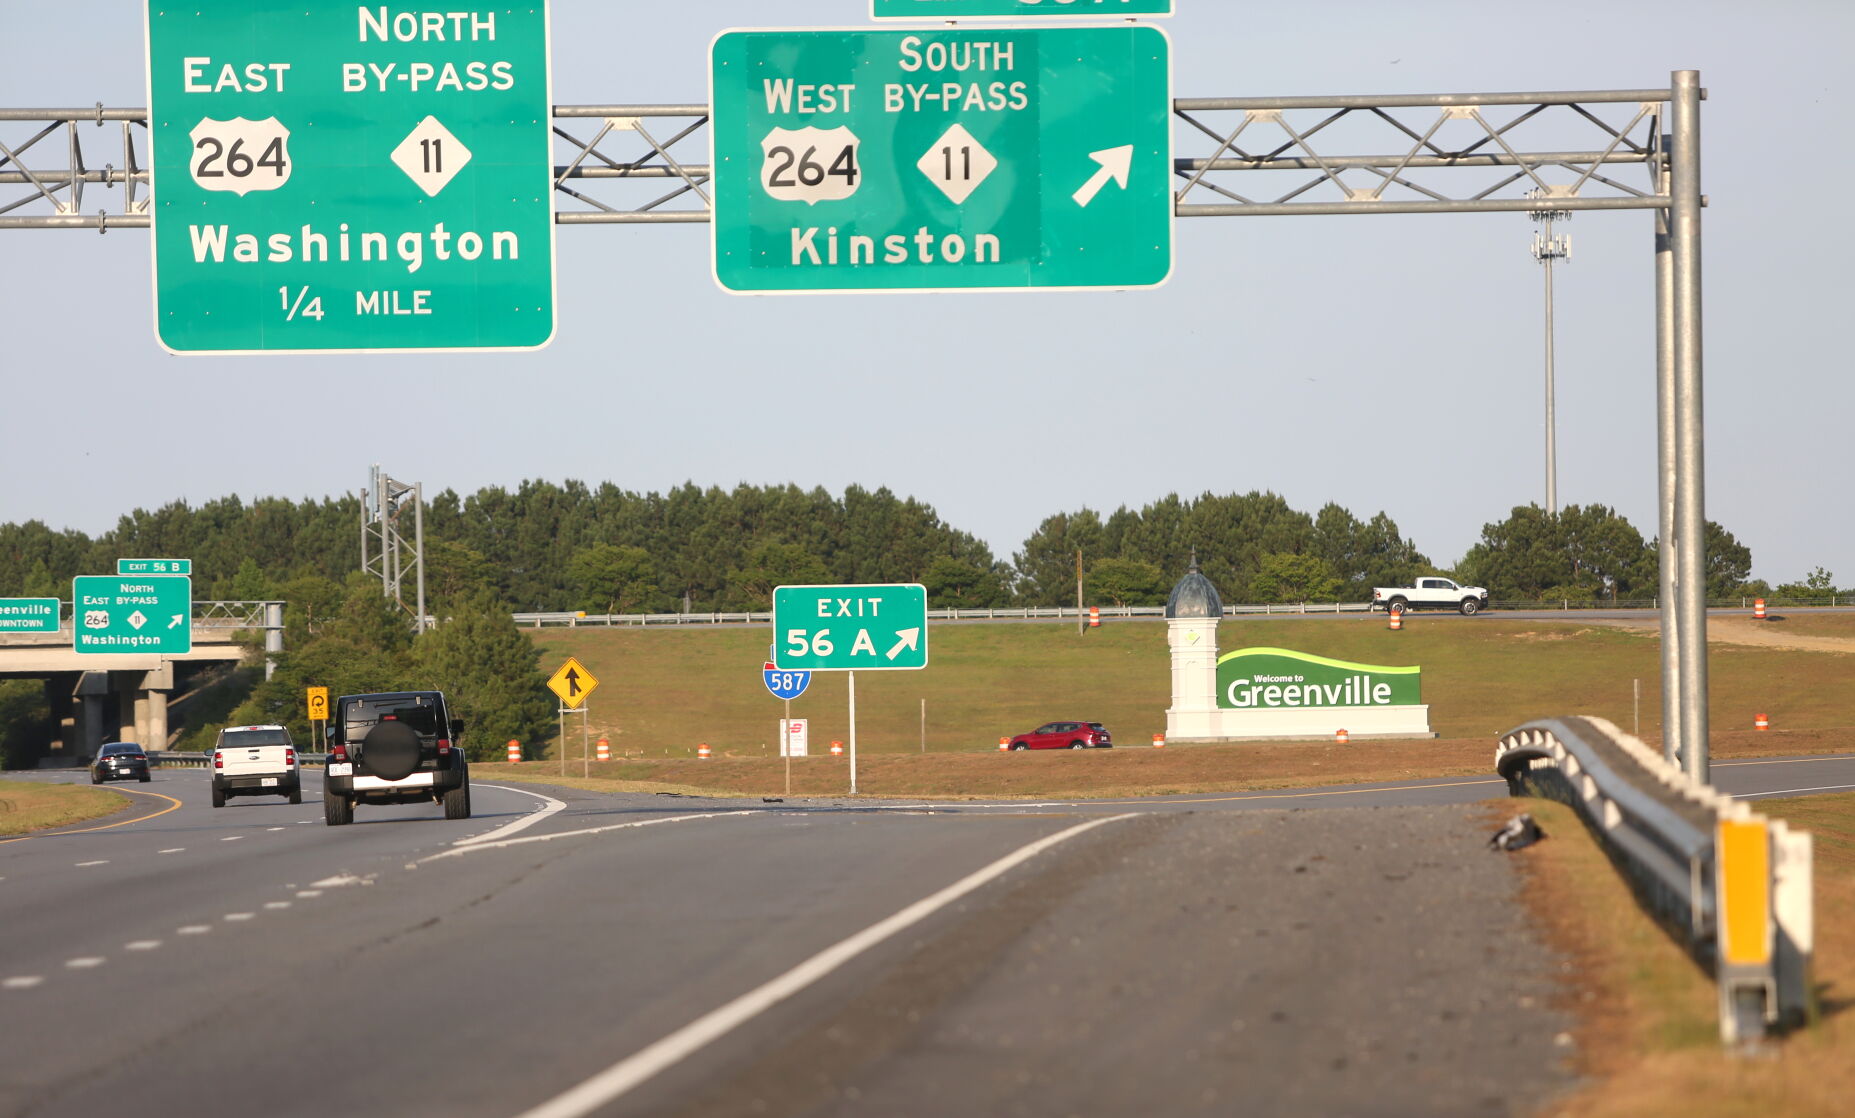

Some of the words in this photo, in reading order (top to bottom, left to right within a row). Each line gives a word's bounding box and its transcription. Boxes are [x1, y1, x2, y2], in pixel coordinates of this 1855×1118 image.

[358, 6, 497, 42] NORTH
[899, 36, 1015, 72] SOUTH
[184, 57, 291, 93] EAST
[343, 61, 515, 92] BY-PASS
[763, 78, 856, 114] WEST
[885, 80, 1028, 113] BY-PASS
[196, 136, 287, 178] 264
[420, 138, 443, 173] 11
[768, 144, 858, 188] 264
[942, 145, 971, 181] 11
[189, 221, 519, 273] Washington
[791, 226, 1000, 265] Kinston
[356, 290, 433, 315] MILE
[129, 563, 148, 571] EXIT
[153, 562, 167, 572] 56
[172, 562, 180, 572] B
[83, 596, 110, 605] EAST
[116, 596, 159, 605] BY-PASS
[120, 584, 154, 593] NORTH
[86, 614, 109, 625] 264
[134, 615, 141, 625] 11
[817, 597, 883, 617] EXIT
[0, 619, 44, 628] WNTOWN
[82, 634, 161, 647] Washington
[786, 628, 835, 657] 56
[850, 628, 877, 656] A
[771, 673, 804, 691] 587
[1227, 675, 1392, 707] Greenville
[1253, 674, 1293, 683] Welcome
[1294, 674, 1304, 683] to
